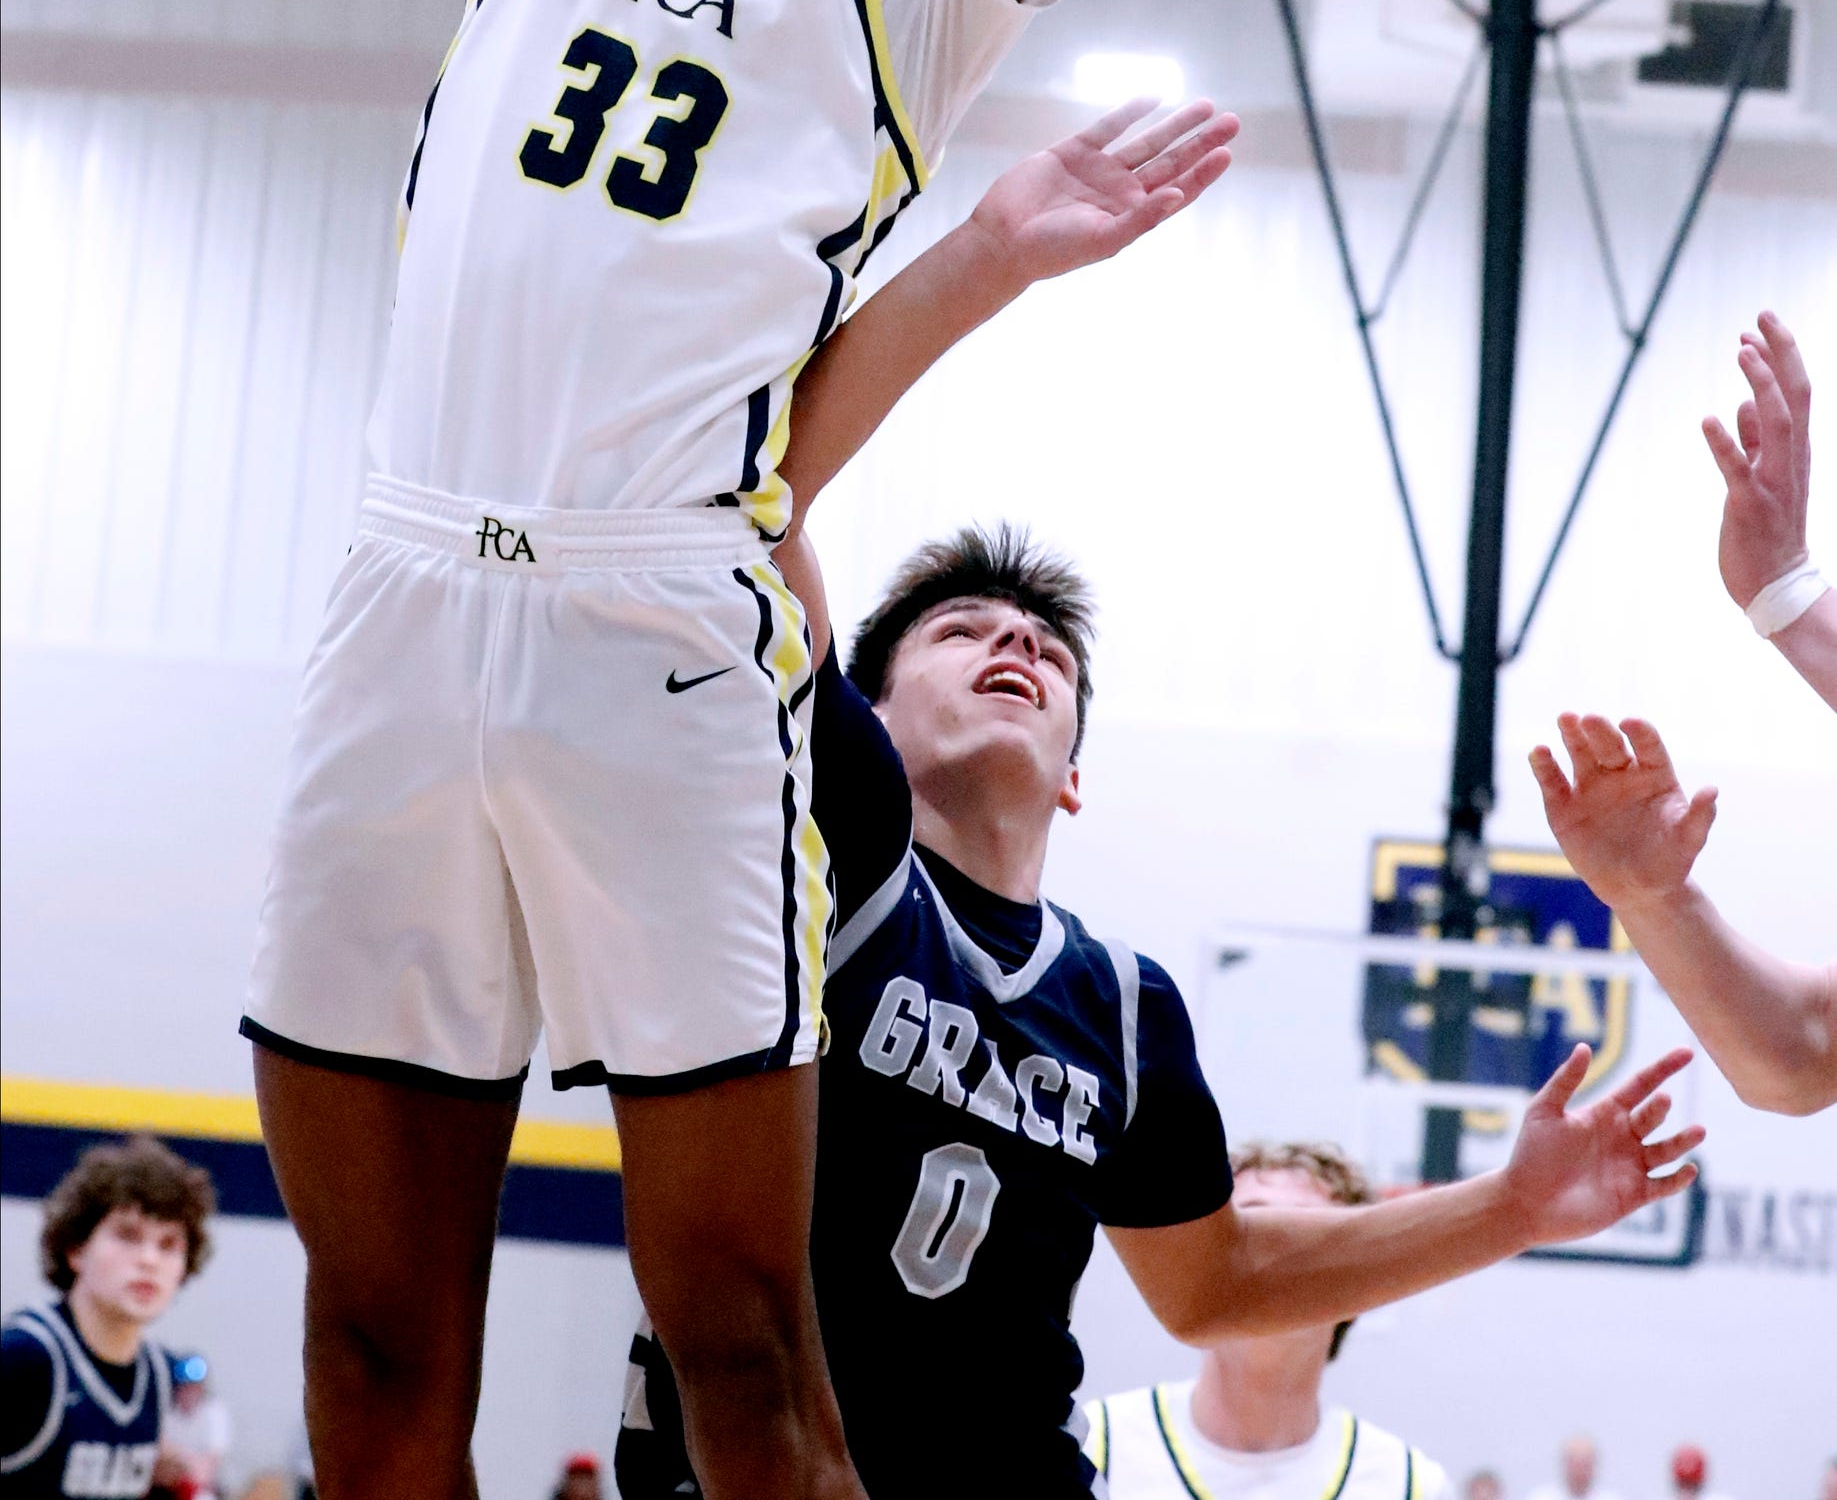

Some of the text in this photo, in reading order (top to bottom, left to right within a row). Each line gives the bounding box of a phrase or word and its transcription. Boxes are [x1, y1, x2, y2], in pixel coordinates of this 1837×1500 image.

[515, 23, 734, 226] 33
[475, 515, 537, 563] PCA
[858, 975, 1101, 1167] GRACE
[890, 1141, 1002, 1300] 0
